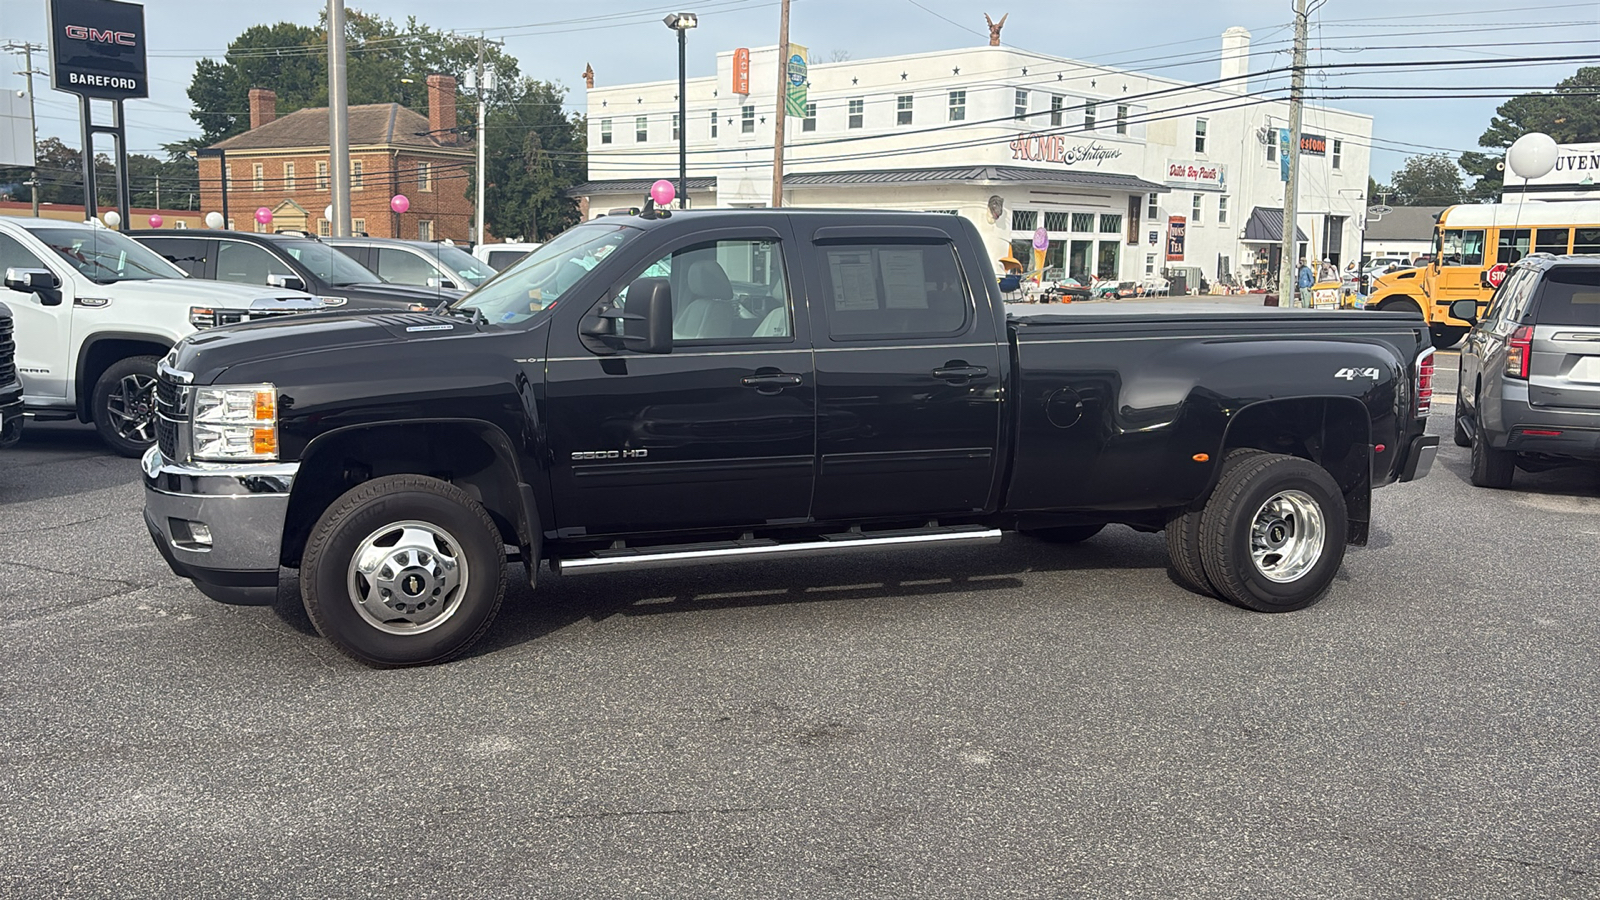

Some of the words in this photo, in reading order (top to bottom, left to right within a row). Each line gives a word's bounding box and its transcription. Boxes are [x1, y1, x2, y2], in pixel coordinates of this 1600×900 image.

[65, 25, 135, 46] GMC
[740, 52, 748, 91] ACME
[69, 73, 136, 90] BAREFORD
[1010, 133, 1065, 163] ACME
[1187, 166, 1198, 180] Boy
[1491, 271, 1506, 281] STO
[571, 450, 619, 460] 3500
[622, 449, 648, 458] HD
